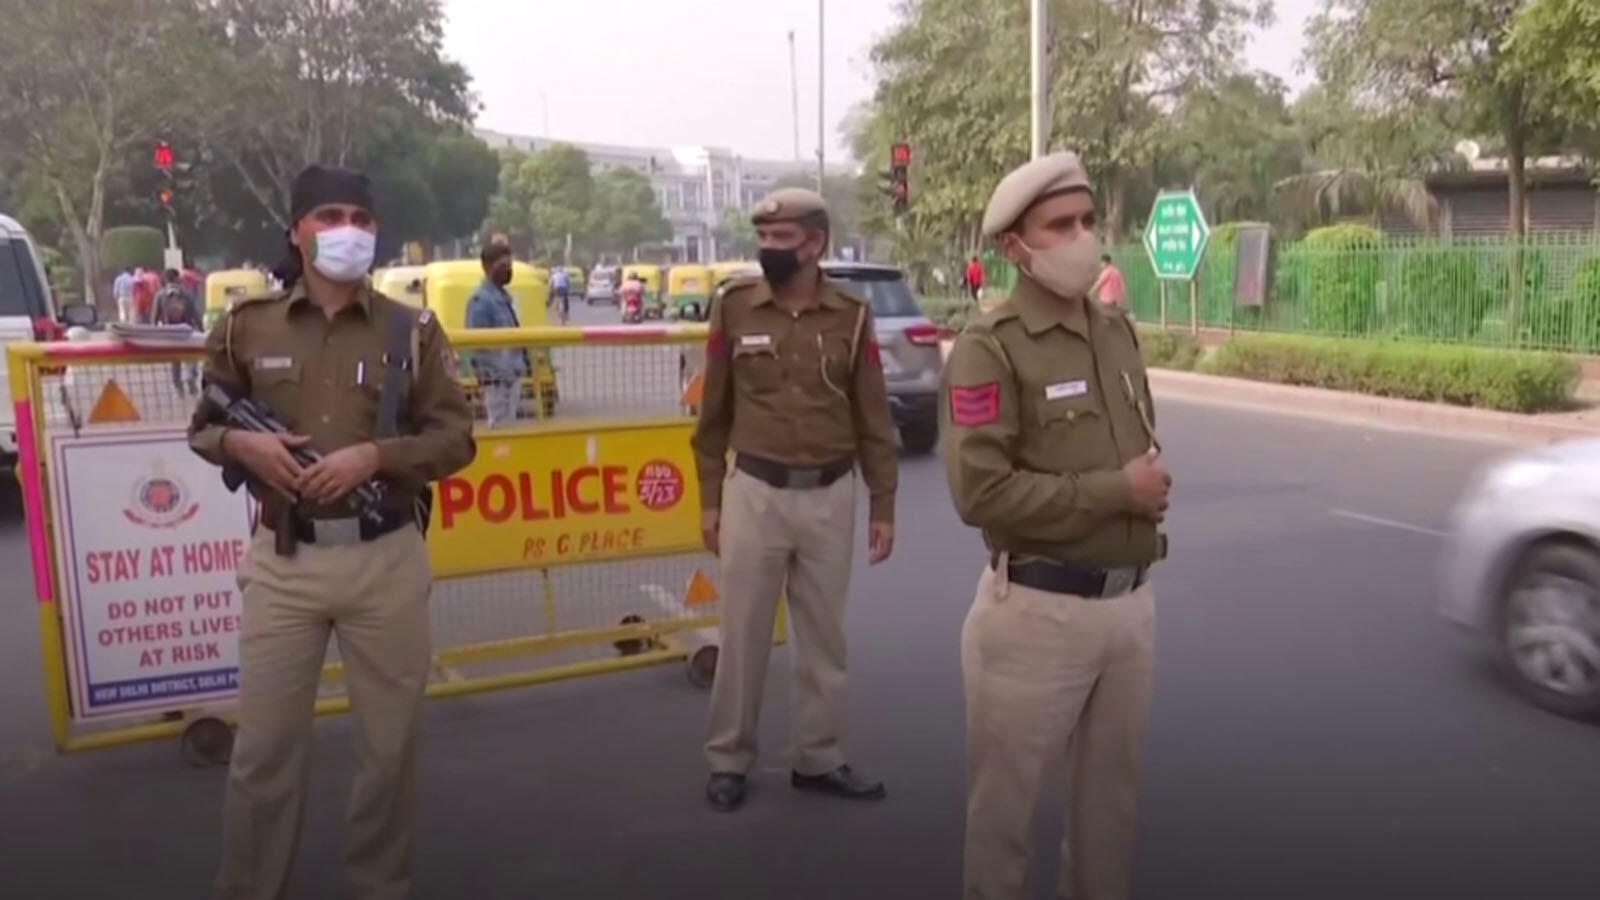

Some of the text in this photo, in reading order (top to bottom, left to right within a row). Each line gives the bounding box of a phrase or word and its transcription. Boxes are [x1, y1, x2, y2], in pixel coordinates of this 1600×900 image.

[438, 465, 630, 530] POLICE
[579, 527, 645, 553] PLACE
[86, 539, 243, 584] STAY AT HOME
[108, 590, 233, 620] DO NOT PUT
[98, 621, 183, 646] OTHERS
[139, 642, 220, 668] AT RISK
